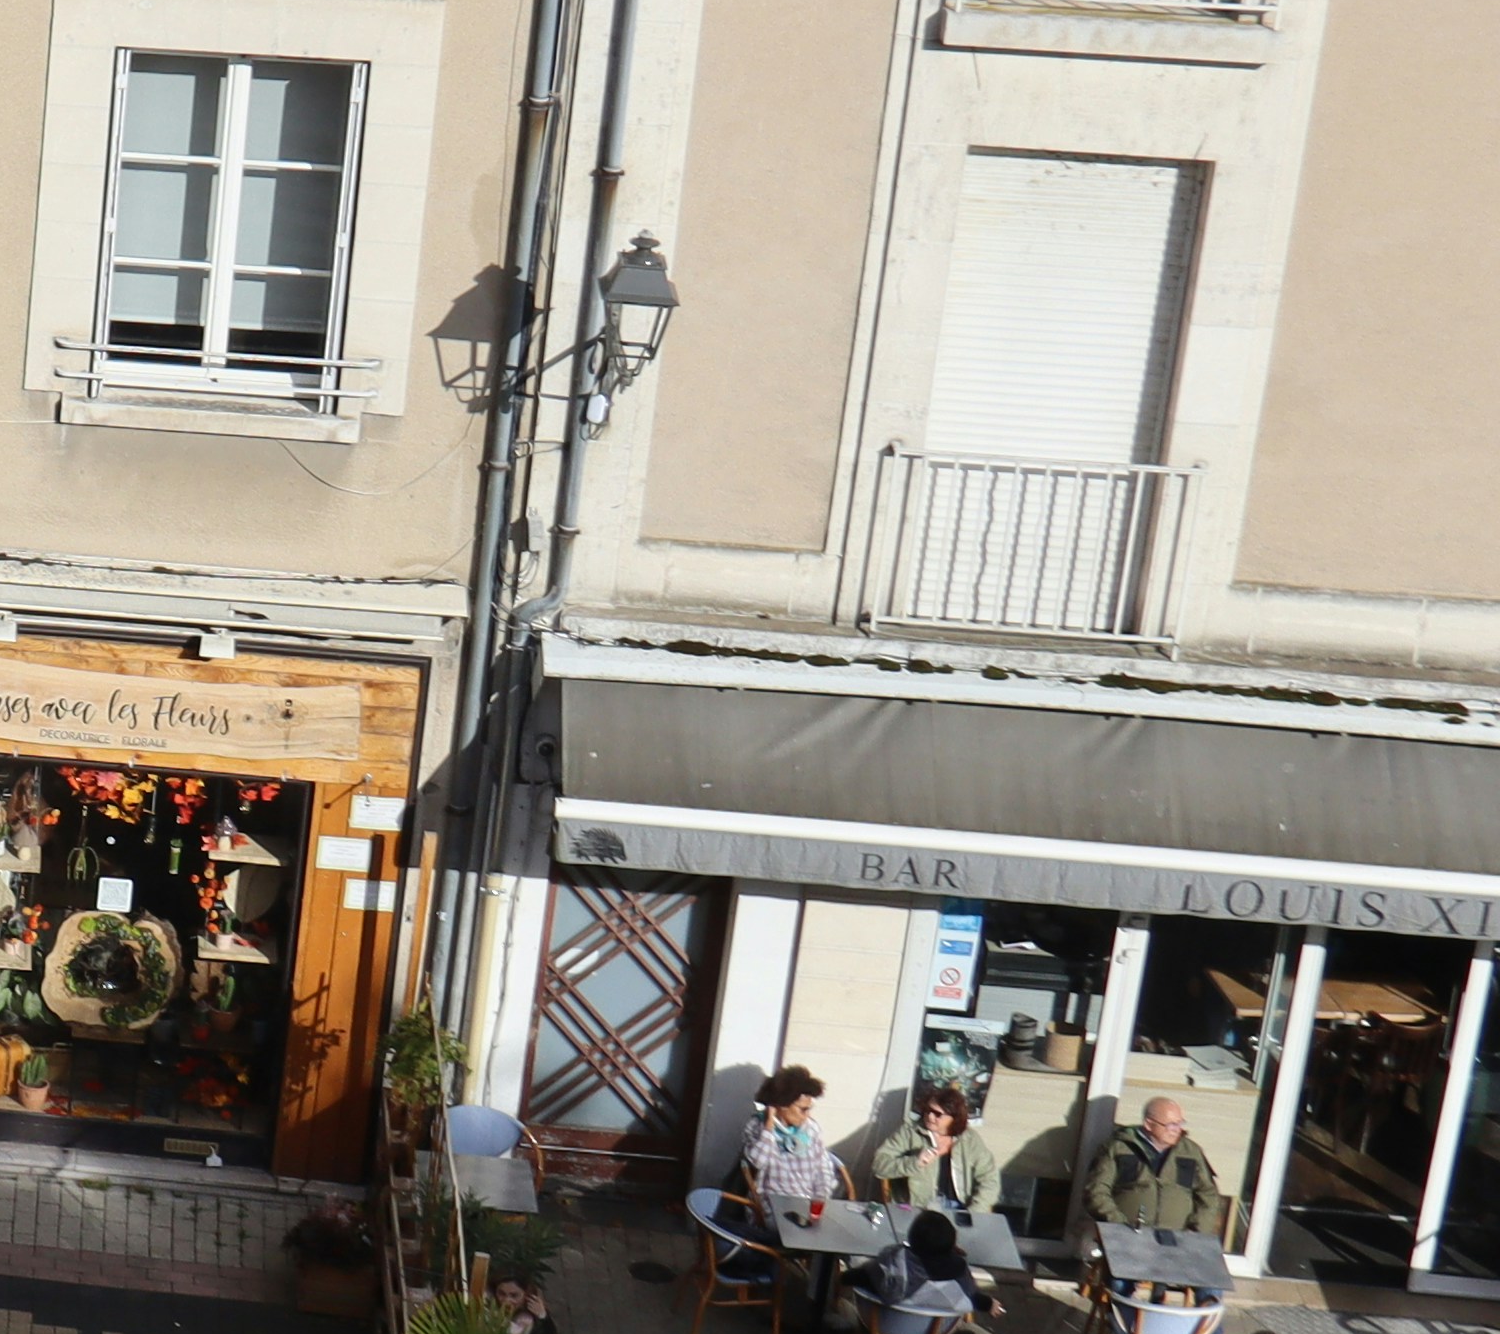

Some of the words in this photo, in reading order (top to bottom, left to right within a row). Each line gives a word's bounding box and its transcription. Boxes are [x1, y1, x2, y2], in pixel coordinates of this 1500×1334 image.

[41, 697, 96, 725] avec
[108, 688, 138, 730] les
[152, 692, 230, 736] Fleurs
[859, 853, 959, 889] BAR
[1180, 880, 1387, 930] LOUIS
